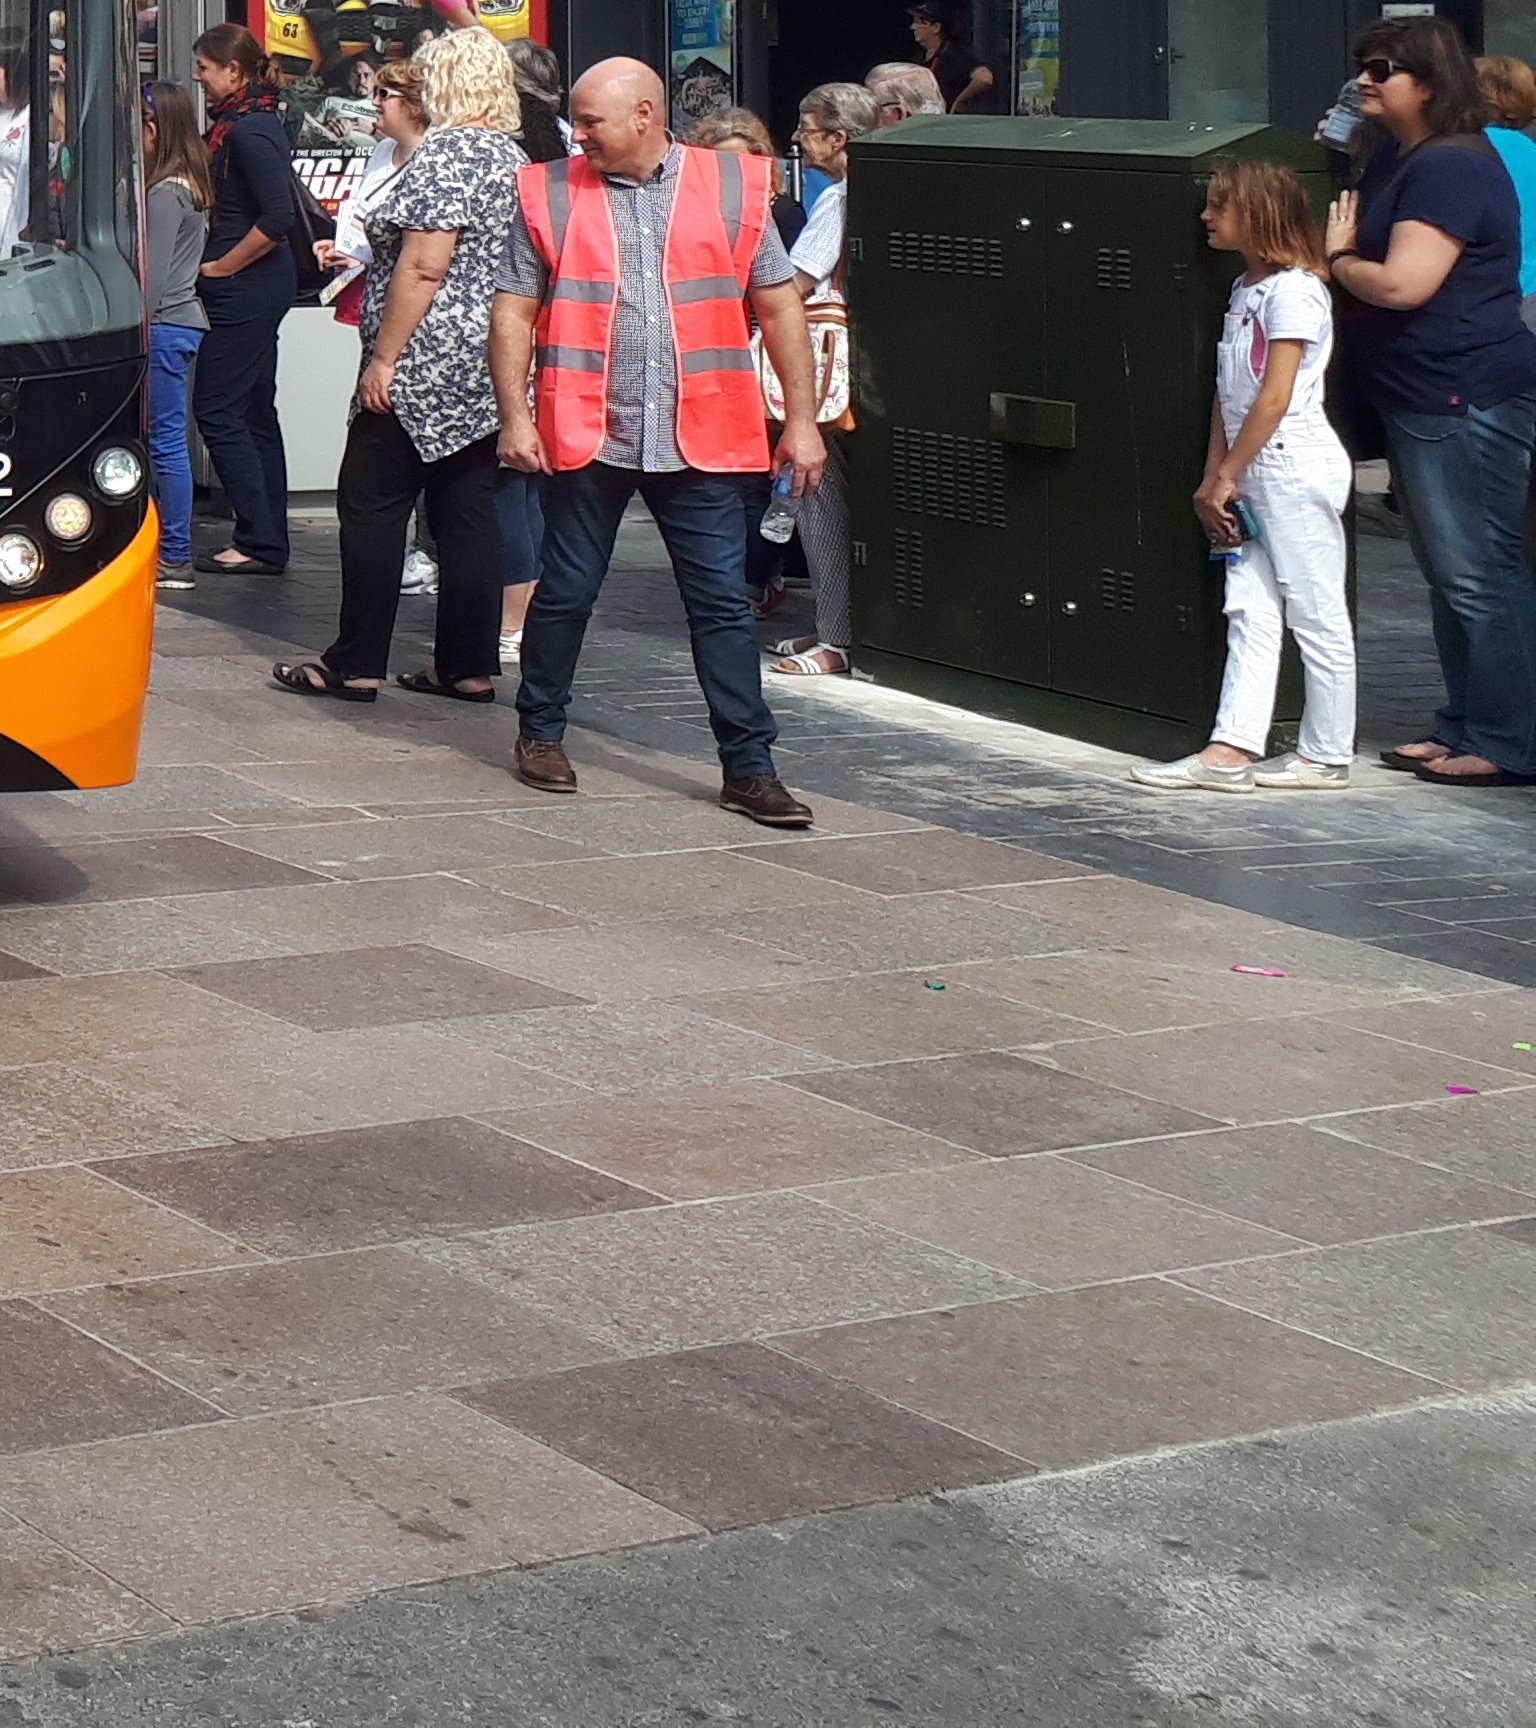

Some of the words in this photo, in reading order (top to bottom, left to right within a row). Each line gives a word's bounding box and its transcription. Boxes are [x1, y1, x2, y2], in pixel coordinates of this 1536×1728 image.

[282, 22, 299, 38] 63
[355, 146, 374, 157] OCE
[291, 158, 366, 200] OGA
